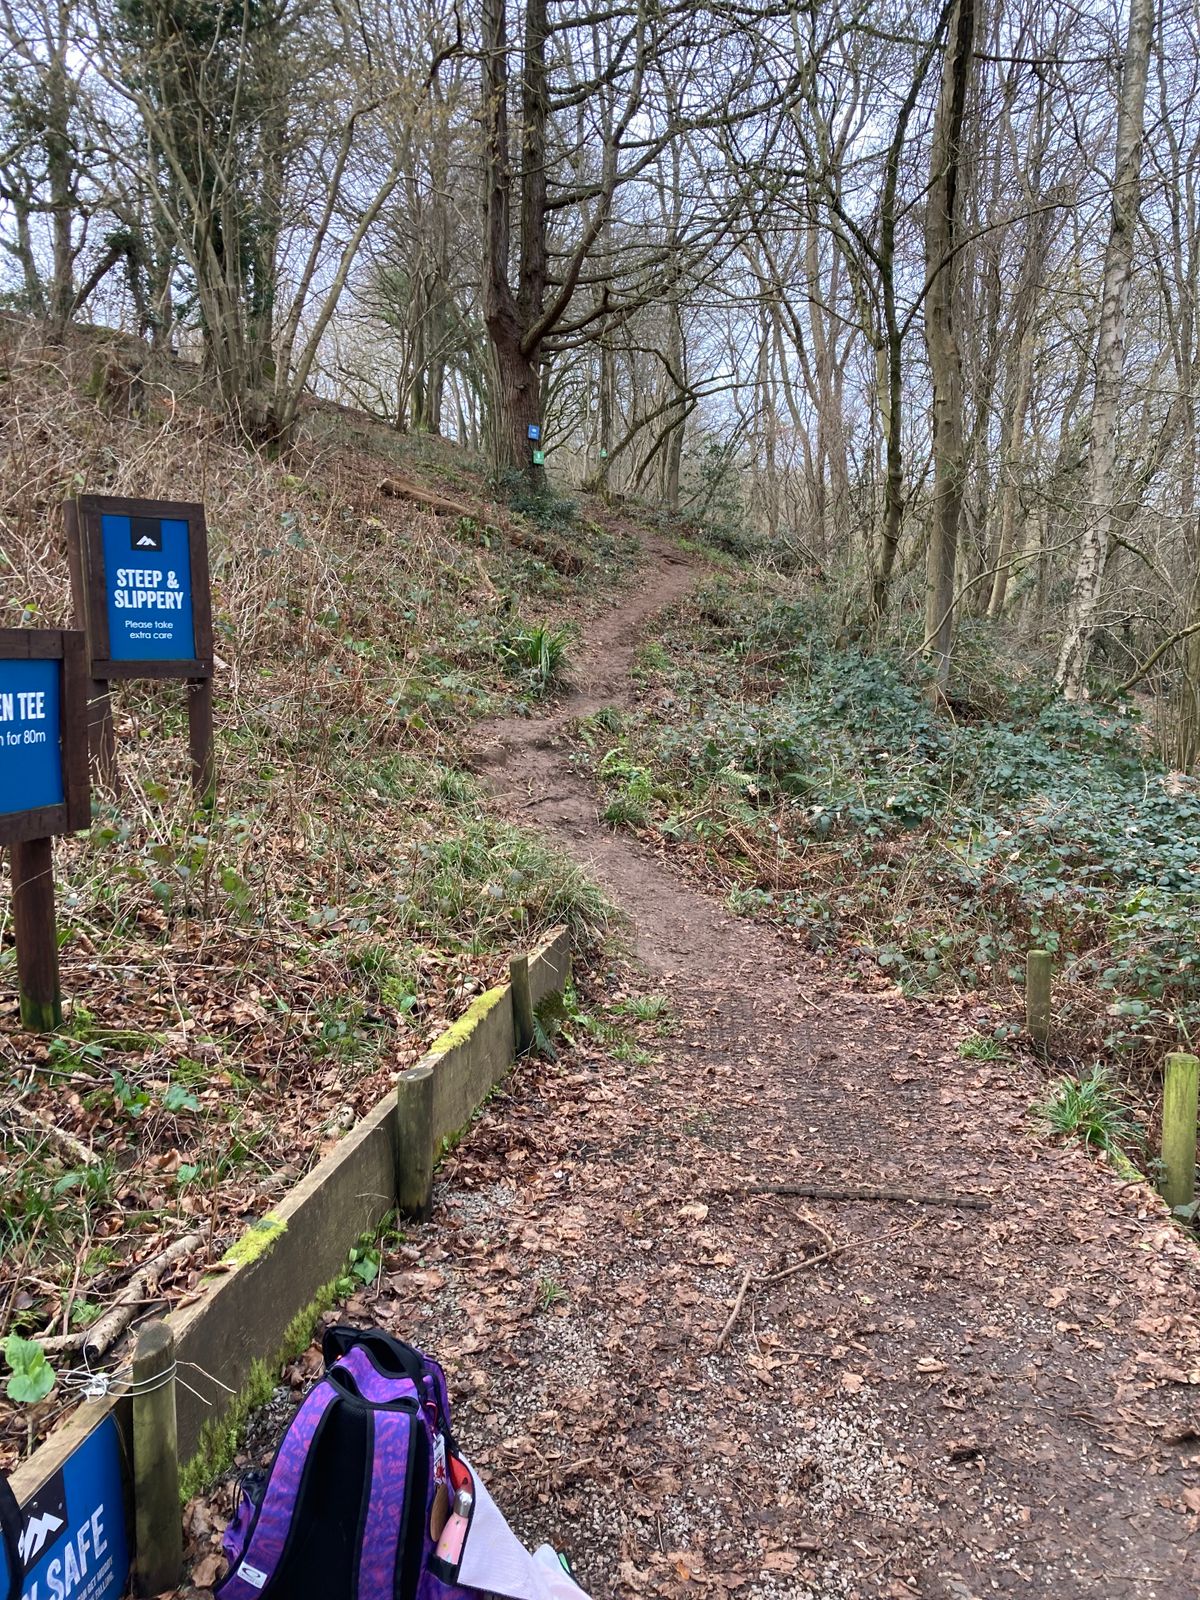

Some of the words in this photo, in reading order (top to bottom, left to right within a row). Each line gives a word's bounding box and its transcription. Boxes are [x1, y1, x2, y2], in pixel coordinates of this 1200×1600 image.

[116, 568, 163, 588] STEEP
[167, 570, 179, 589] &
[114, 589, 184, 609] SLIPPERY
[125, 620, 153, 629] Please
[154, 620, 174, 629] take
[129, 631, 152, 639] extra
[153, 632, 173, 640] care
[17, 692, 45, 720] TEE
[6, 731, 22, 746] for
[23, 729, 46, 744] 80m
[47, 1503, 108, 1600] SAFE
